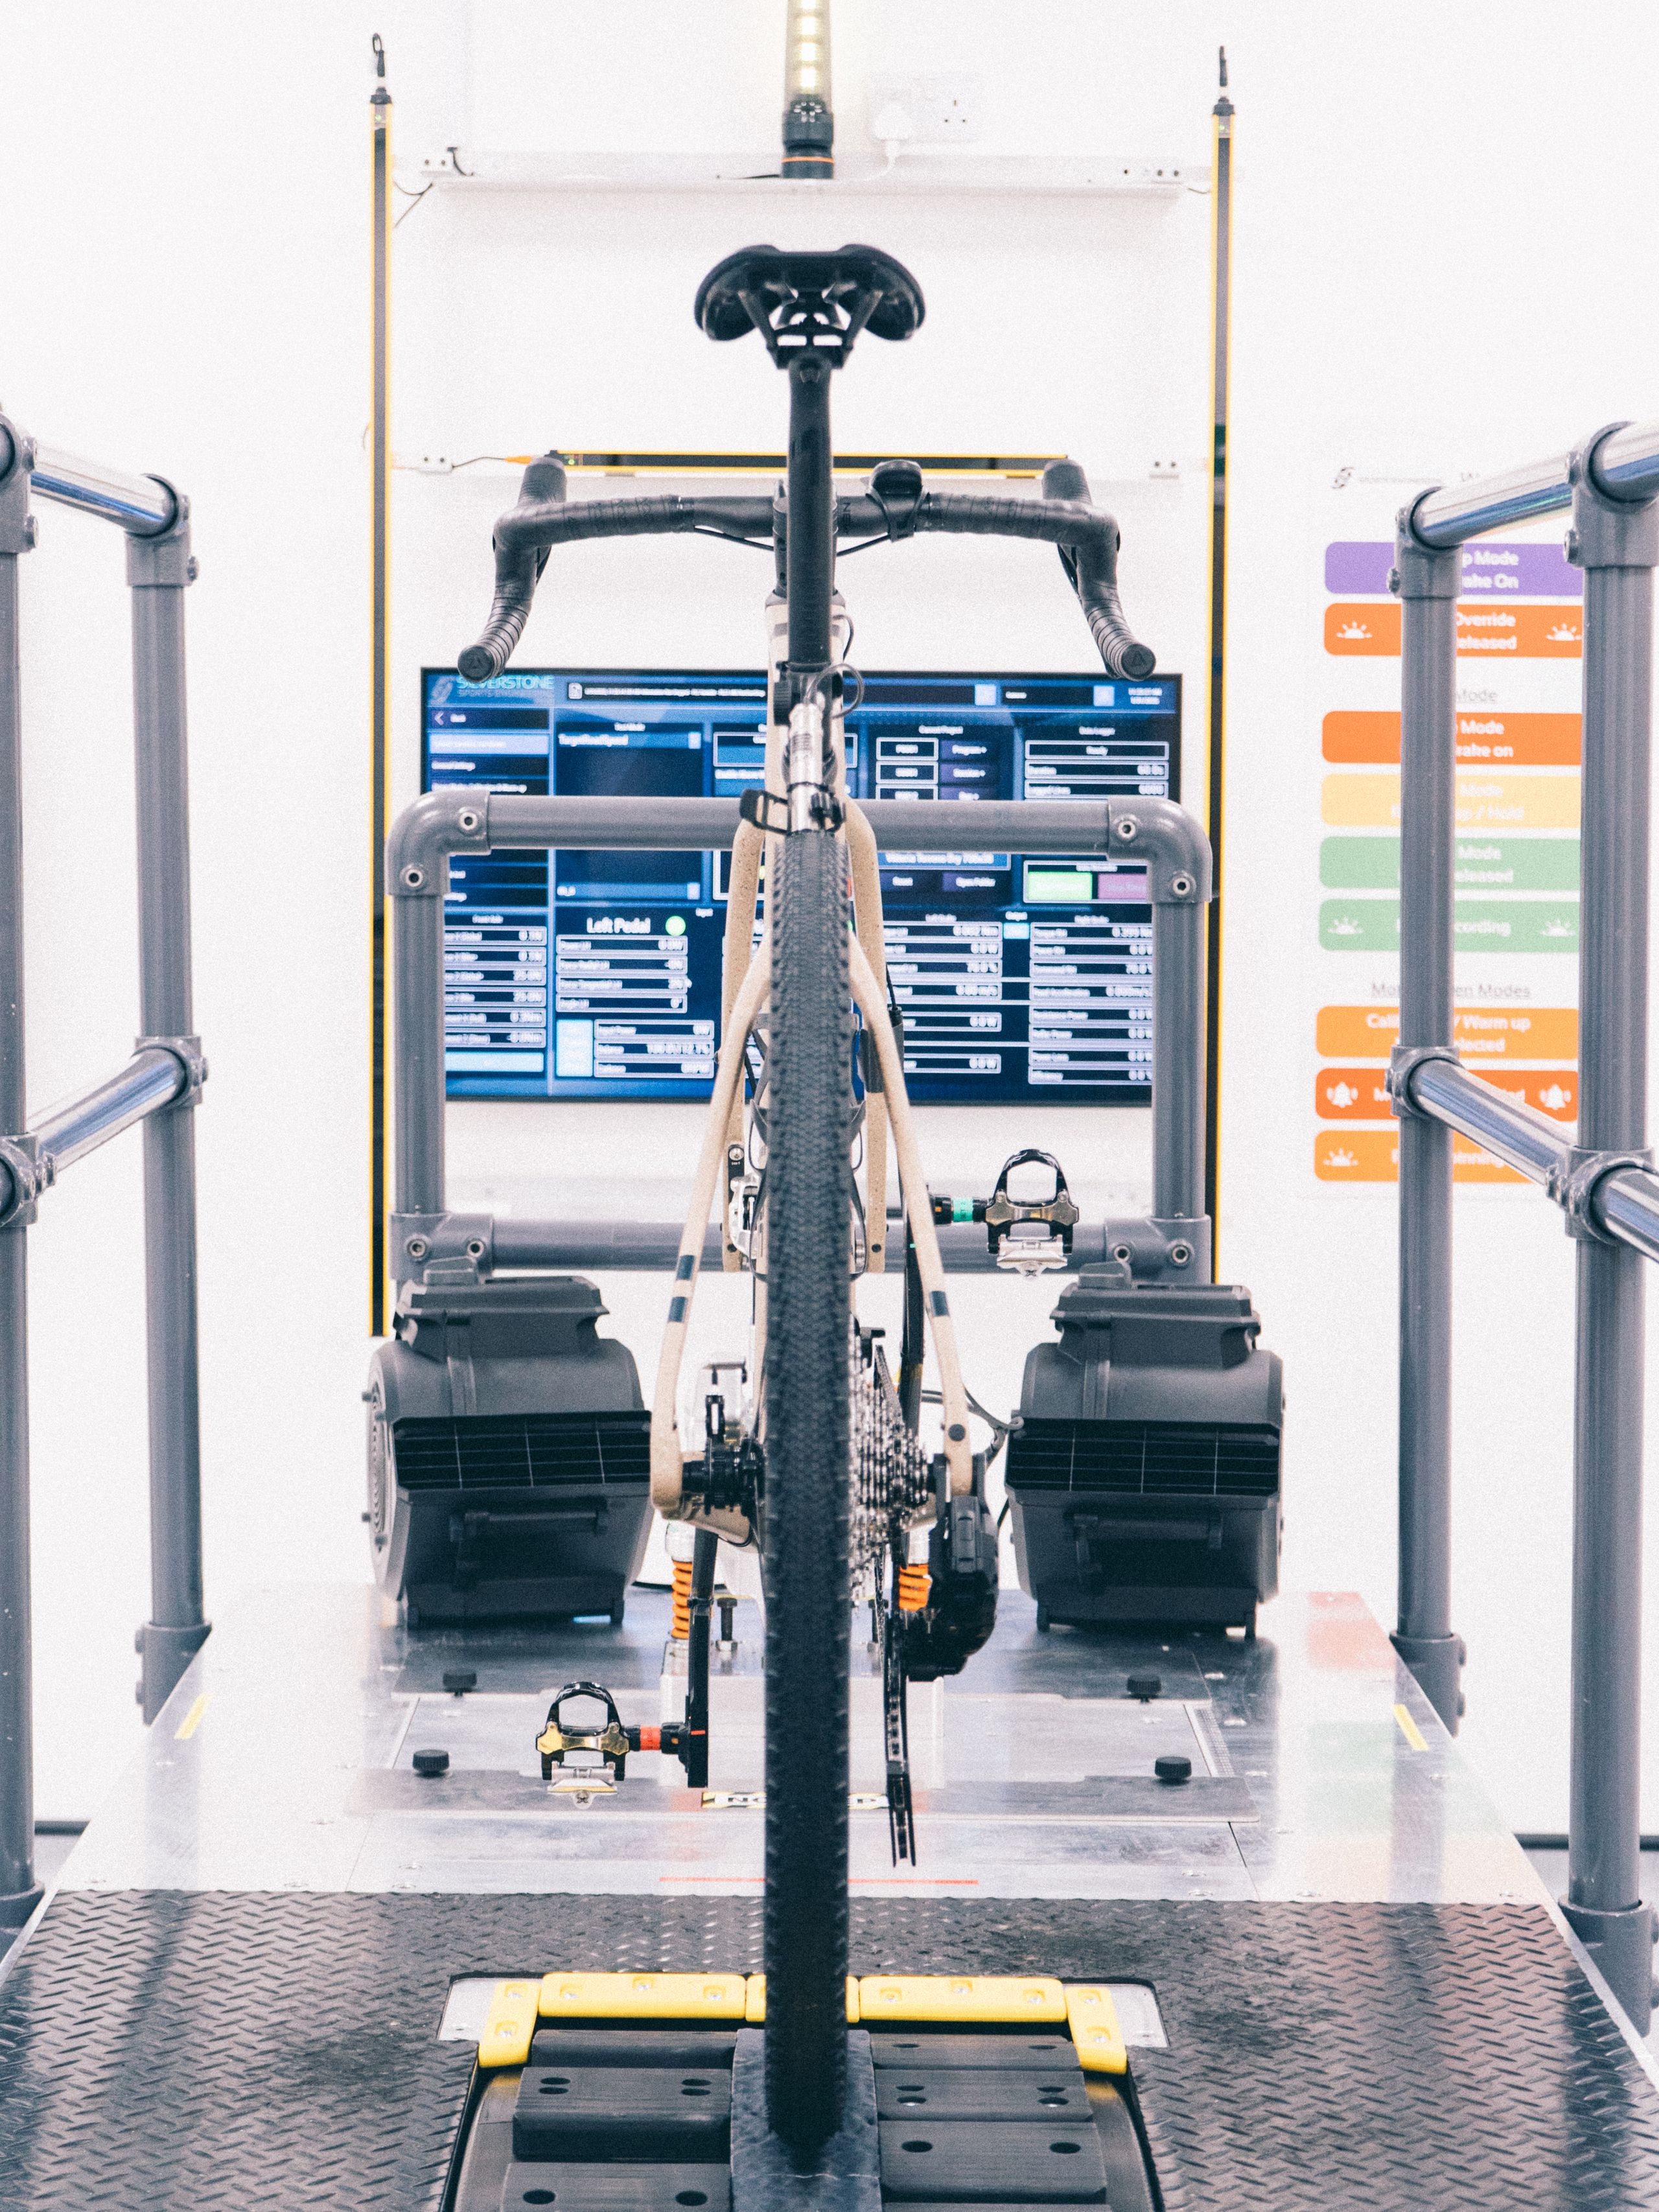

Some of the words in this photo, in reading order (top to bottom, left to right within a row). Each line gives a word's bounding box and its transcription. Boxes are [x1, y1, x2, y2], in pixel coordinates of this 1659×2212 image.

[1462, 573, 1492, 588] ake
[1457, 635, 1517, 649] eleased
[1456, 743, 1491, 757] rake
[586, 917, 613, 933] Left
[614, 917, 651, 933] Pedal
